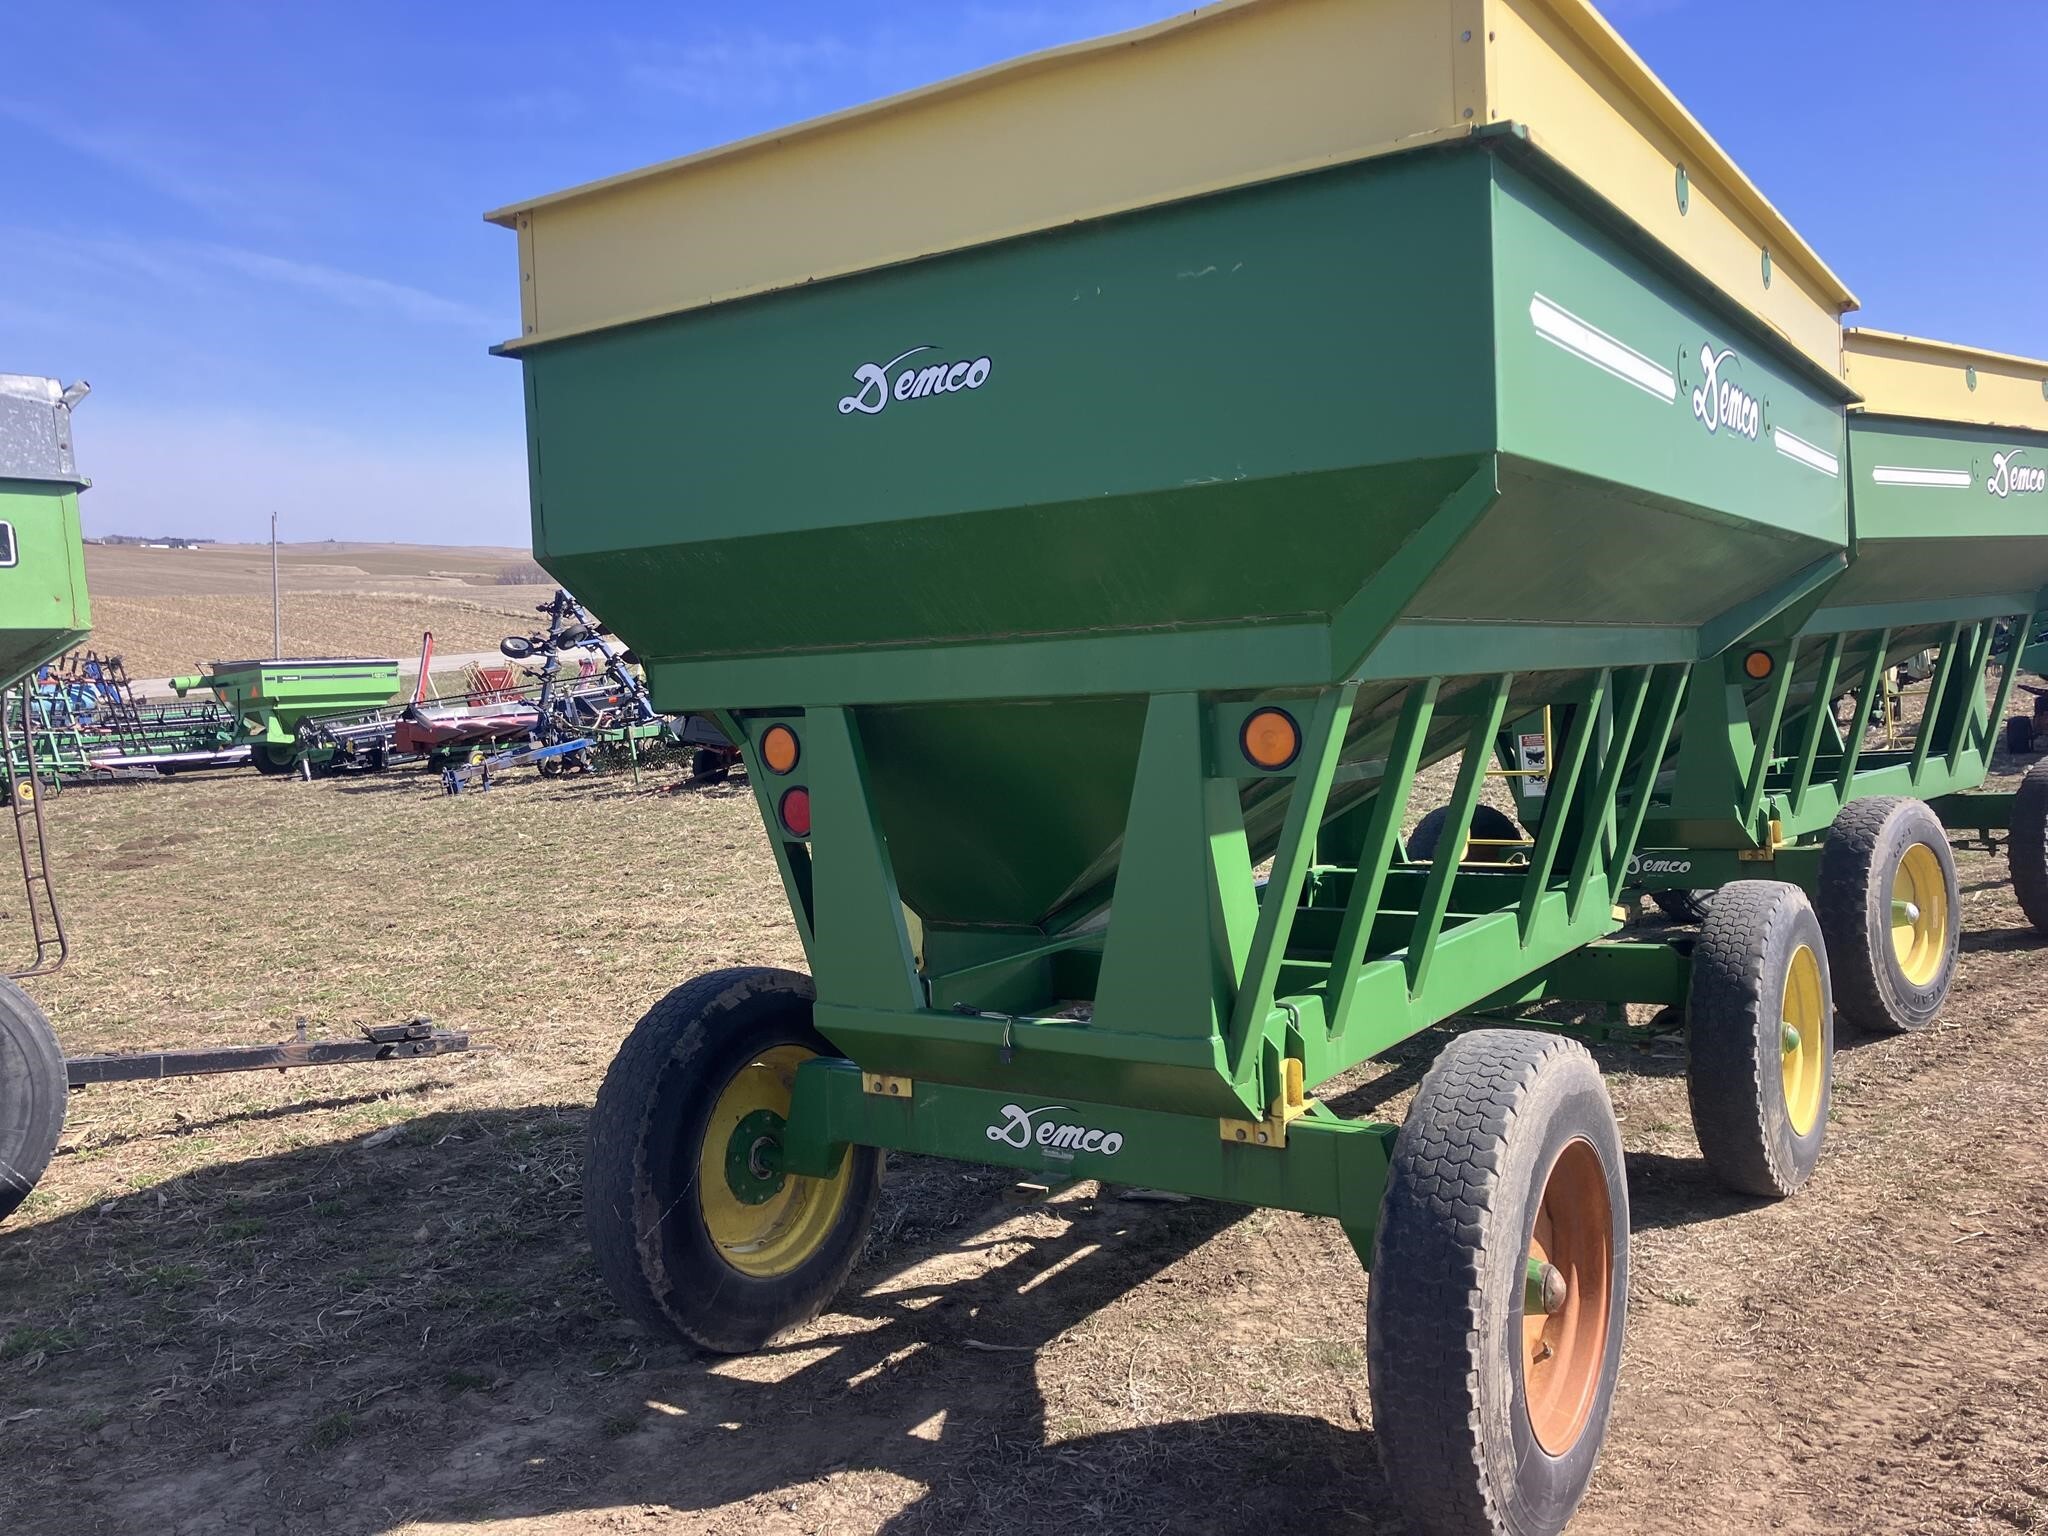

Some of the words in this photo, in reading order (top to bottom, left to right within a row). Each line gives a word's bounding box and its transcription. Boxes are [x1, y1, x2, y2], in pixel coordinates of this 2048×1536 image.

[837, 344, 993, 415] Demco
[1693, 341, 1760, 442] Demco
[1987, 449, 2045, 499] Demco
[985, 1102, 1124, 1156] Demco
